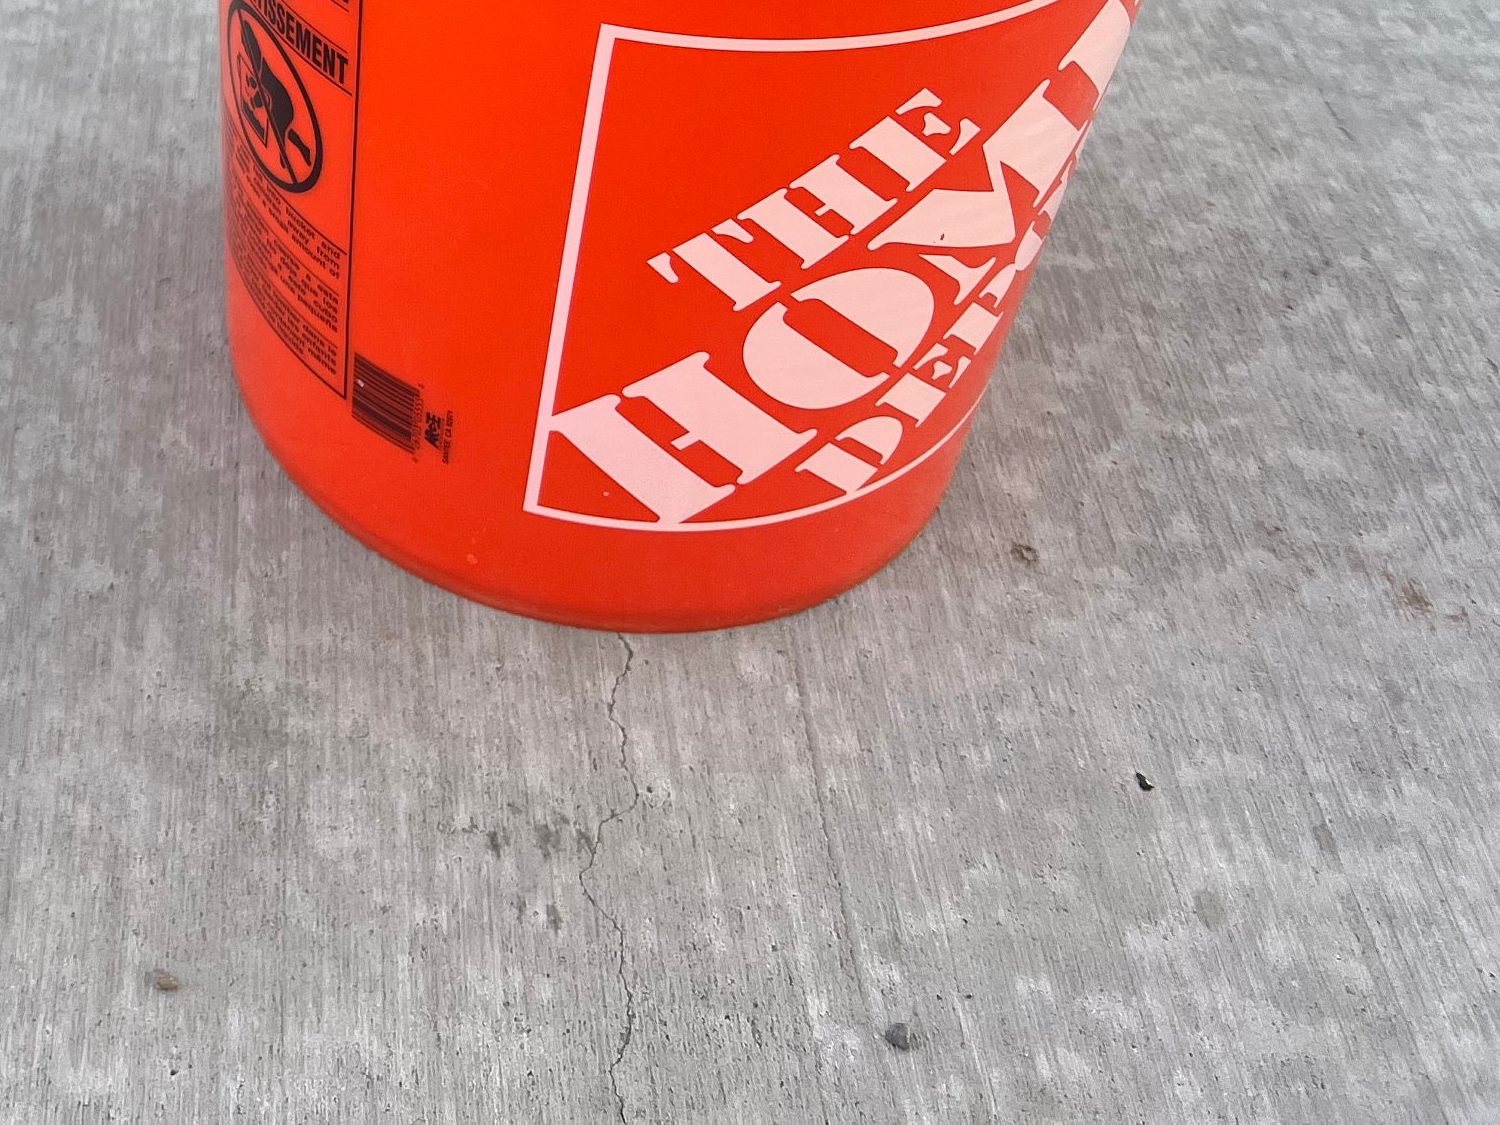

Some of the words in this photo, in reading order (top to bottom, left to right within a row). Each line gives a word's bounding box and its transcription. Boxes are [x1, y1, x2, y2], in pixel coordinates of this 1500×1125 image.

[646, 87, 981, 312] THE
[285, 207, 315, 239] bucket
[321, 241, 340, 259] and
[291, 234, 325, 268] amount
[329, 268, 339, 279] of
[316, 246, 339, 269] from
[794, 118, 1095, 495] DEPO
